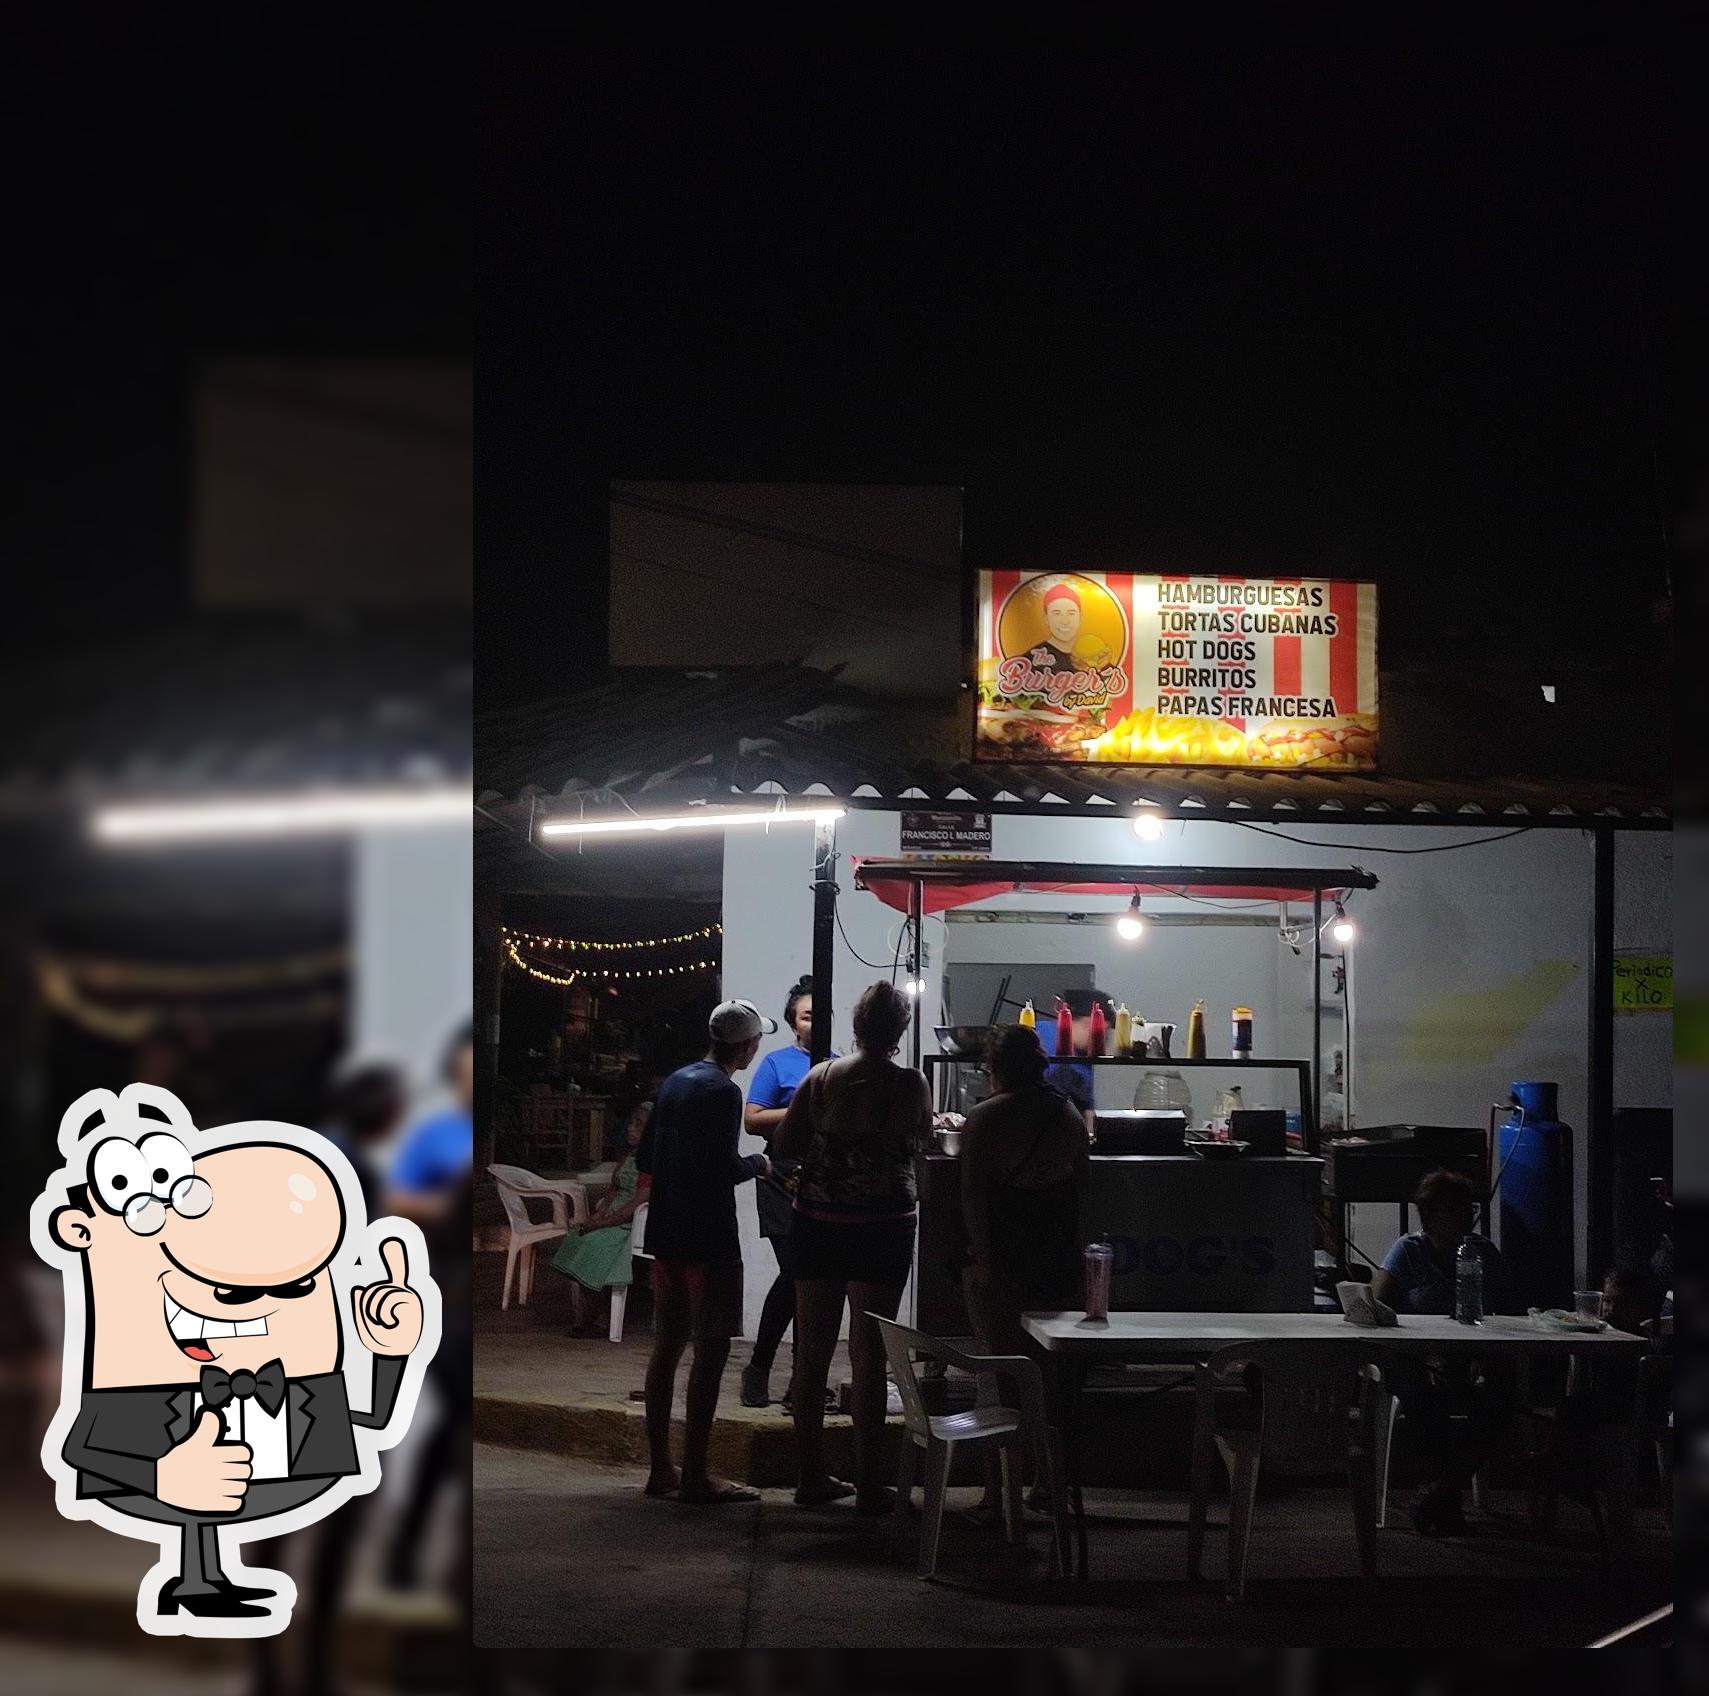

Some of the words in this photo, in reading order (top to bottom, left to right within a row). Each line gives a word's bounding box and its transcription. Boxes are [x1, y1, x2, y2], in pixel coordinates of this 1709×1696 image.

[1157, 583, 1324, 608] HAMBURGUESAS
[1158, 611, 1235, 633] TORTAS
[1240, 612, 1337, 636] CUBANAS
[1031, 647, 1056, 667] The
[1157, 639, 1195, 661] HOT
[1203, 640, 1257, 662] DOGS
[1157, 667, 1257, 690] BURRITOS
[1157, 696, 1223, 717] PAPAS
[1229, 696, 1336, 719] FRANCESA
[902, 831, 949, 840] FRANCISCO
[956, 831, 991, 840] MADERO
